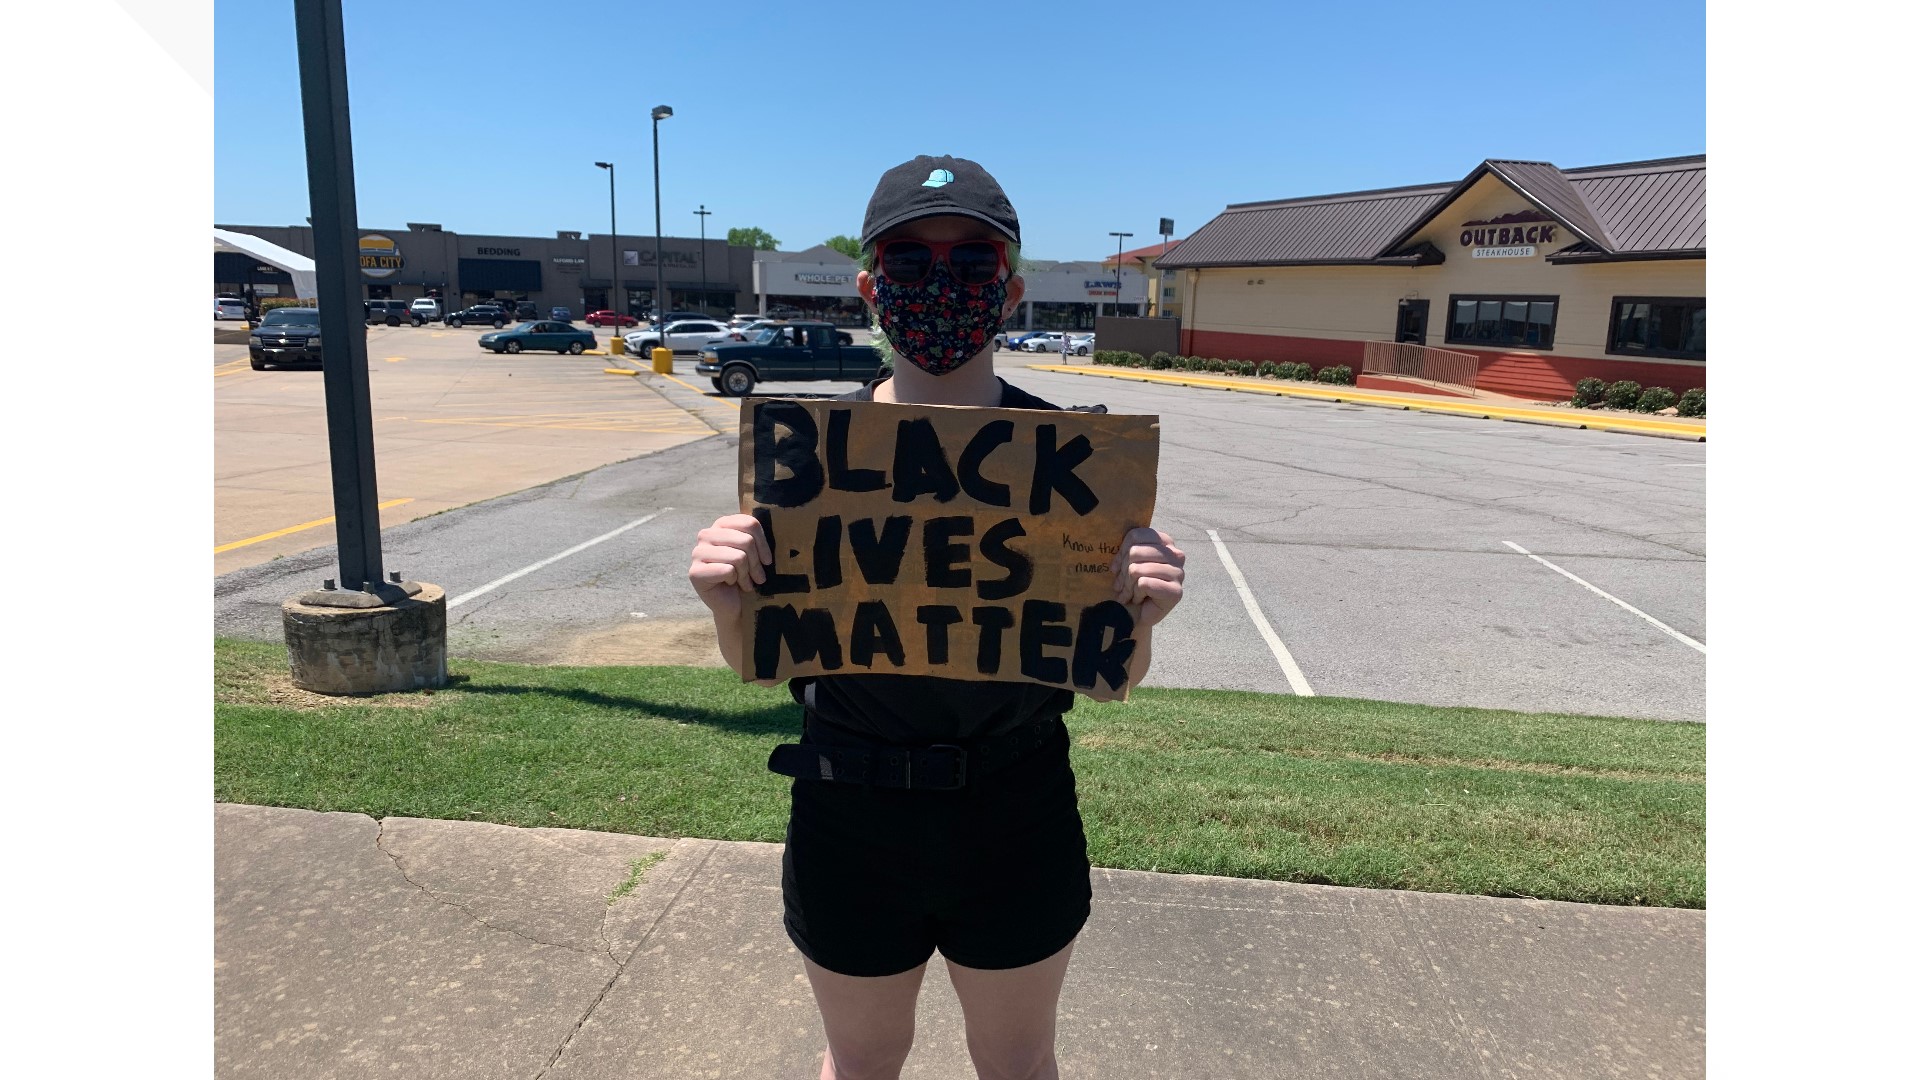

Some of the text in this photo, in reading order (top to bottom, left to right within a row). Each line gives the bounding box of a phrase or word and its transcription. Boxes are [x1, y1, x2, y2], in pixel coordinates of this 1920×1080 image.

[1460, 226, 1554, 246] OUTBACK
[477, 247, 521, 256] BEDDING
[640, 251, 697, 263] CAPITAL
[1476, 247, 1531, 257] STEAKHOUSE
[360, 256, 401, 268] OFA CITY
[798, 273, 833, 282] WHOLE
[835, 274, 853, 283] PET
[753, 400, 1100, 516] BLACK
[751, 507, 1035, 601] LIVES
[753, 598, 1137, 692] MATTER
